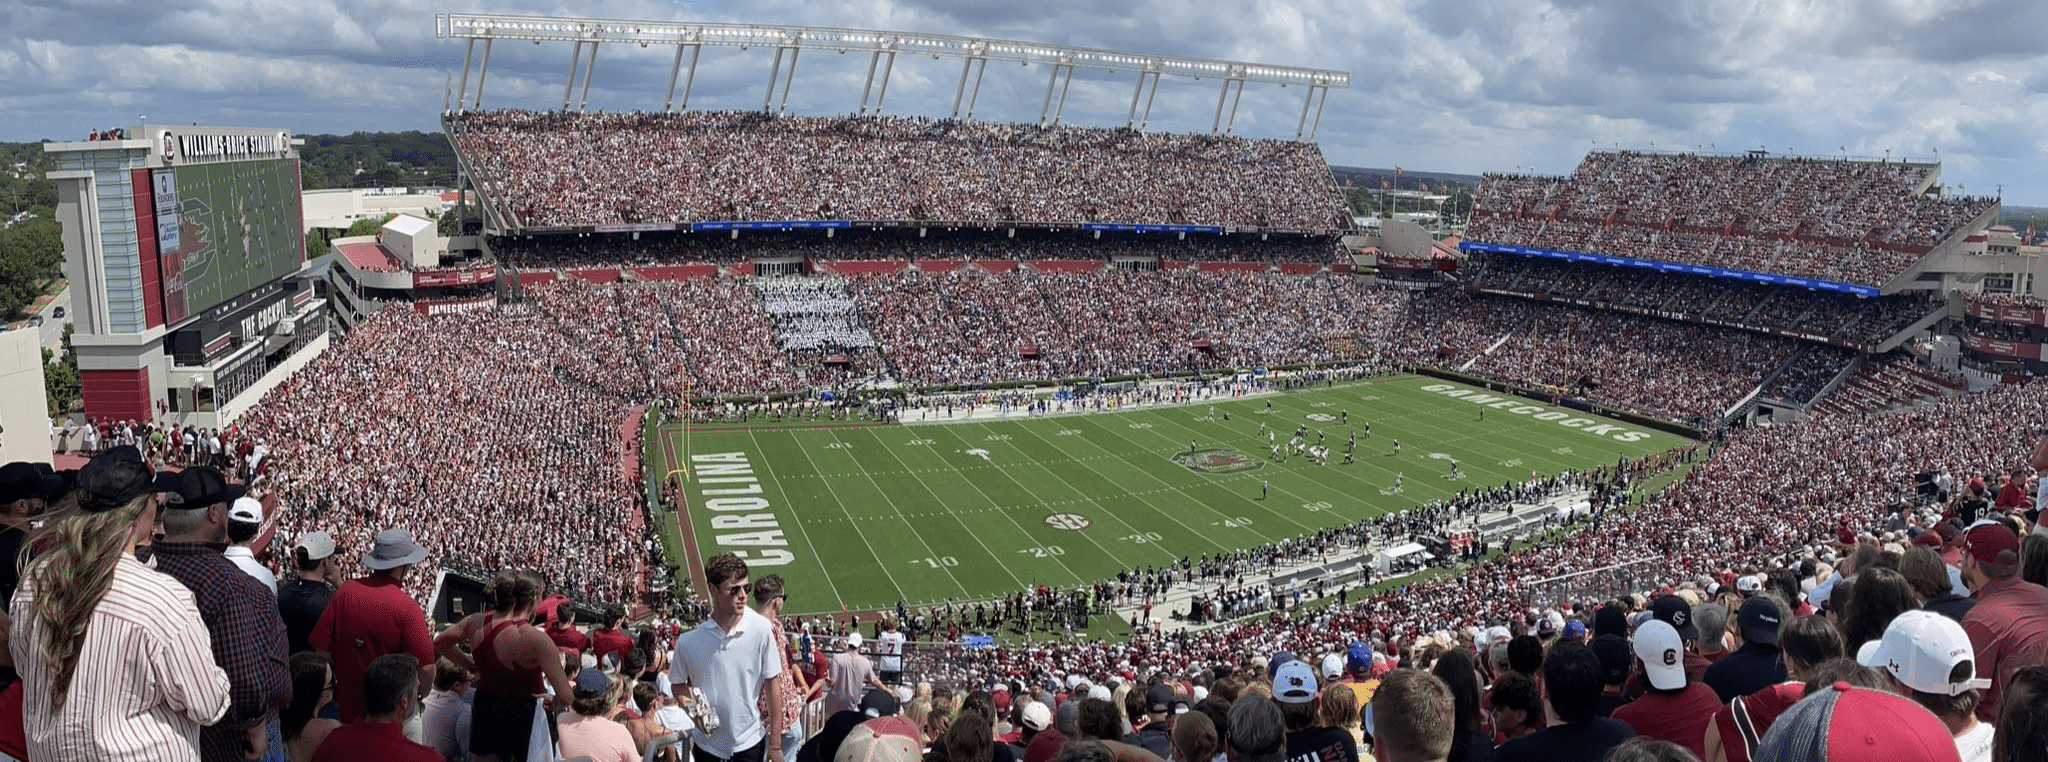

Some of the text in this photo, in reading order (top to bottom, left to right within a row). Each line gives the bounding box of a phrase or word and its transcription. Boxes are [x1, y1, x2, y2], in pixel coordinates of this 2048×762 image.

[250, 135, 277, 152] STADIUM
[241, 314, 256, 343] THE
[257, 298, 287, 331] COCKPIT
[1806, 334, 1829, 343] BROWN
[1420, 384, 1652, 442] GAMECOCKS
[690, 451, 796, 567] CAROLINA
[1302, 500, 1334, 512] 50
[1975, 507, 1985, 521] 19
[1045, 513, 1090, 530] SEC
[1224, 516, 1253, 528] 40
[1128, 531, 1163, 544] 30
[1029, 545, 1066, 559] 20
[924, 555, 959, 569] 10
[887, 643, 895, 654] 7
